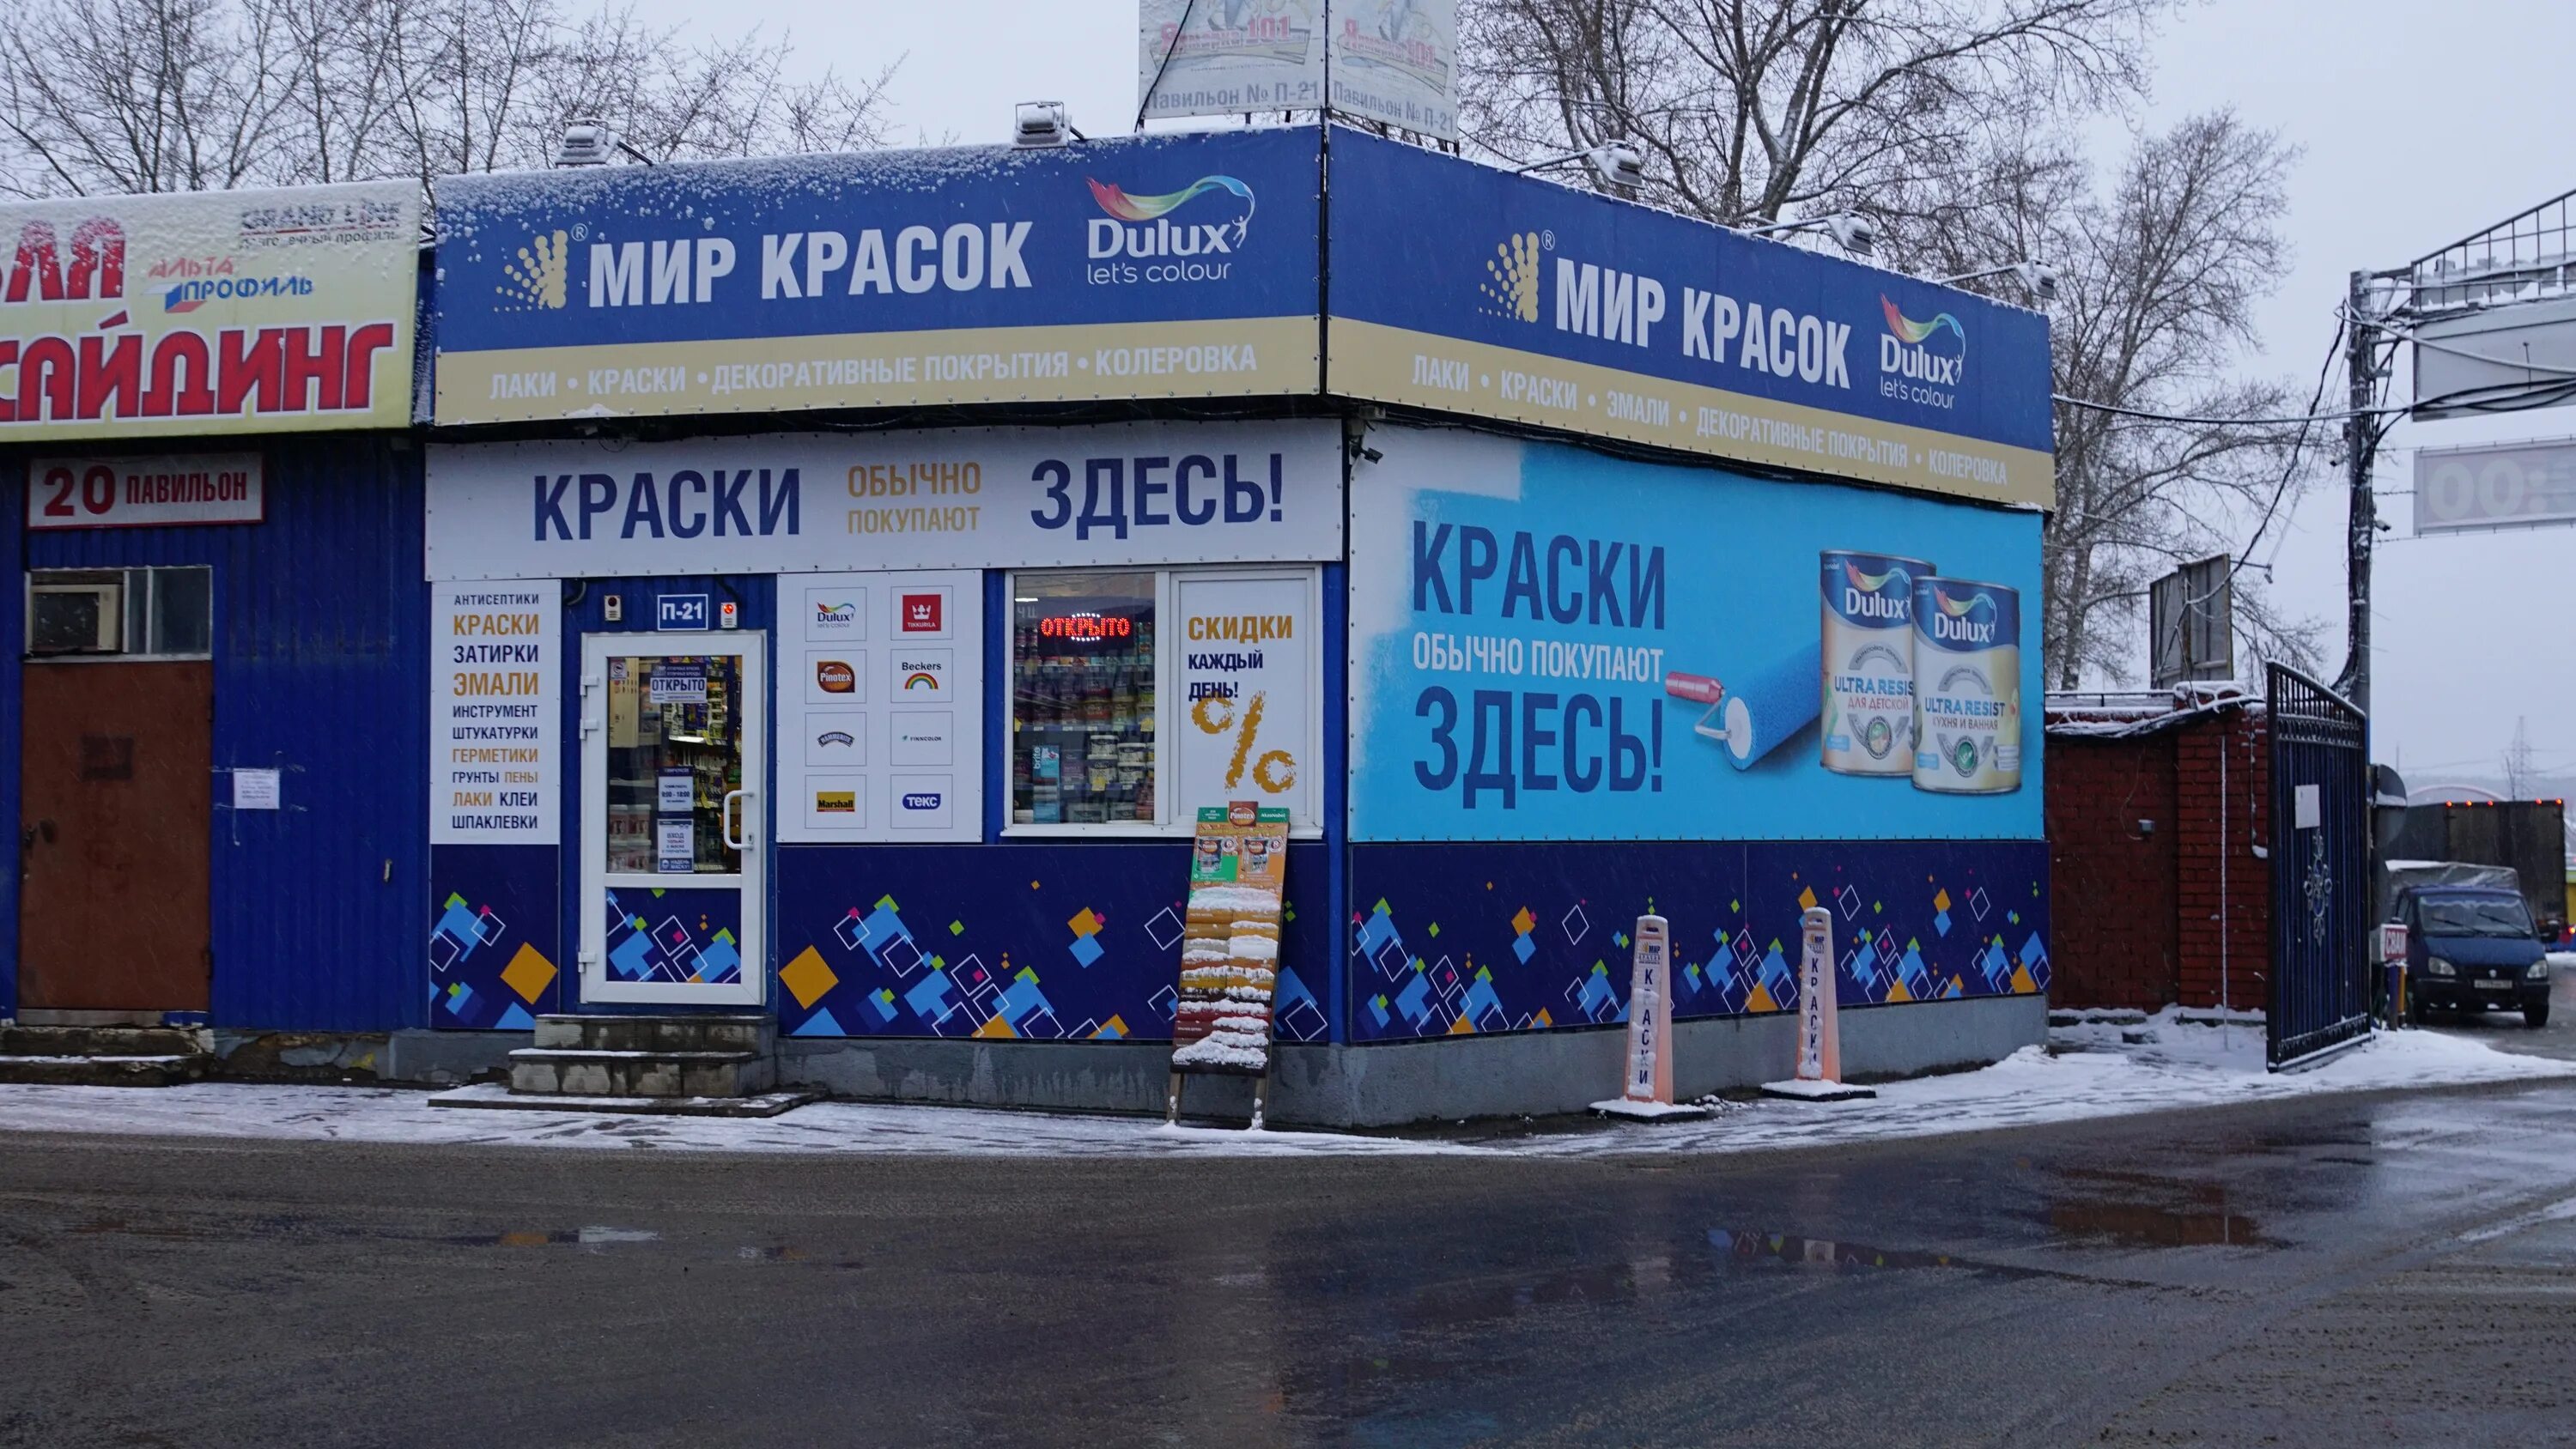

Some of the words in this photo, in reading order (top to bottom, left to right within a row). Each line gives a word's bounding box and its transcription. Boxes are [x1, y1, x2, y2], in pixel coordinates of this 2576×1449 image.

[1145, 88, 1239, 109] Павильон
[1334, 81, 1401, 118] Павильон
[1425, 106, 1453, 133] П-21
[1087, 218, 1232, 258] Dulux
[0, 216, 125, 302] ЛЯ
[589, 238, 736, 307] МИР
[762, 221, 1033, 300] КРАСОК
[1145, 259, 1231, 283] colour
[182, 276, 314, 300] ПРОФИЛЬ
[1556, 257, 1667, 348] МИР
[1683, 287, 1851, 390] КРАСОК
[1880, 333, 1955, 386] Dulux
[489, 372, 556, 400] ЛАКИ
[587, 366, 685, 395] КРАСКИ
[712, 356, 917, 395] ДЕКОРАТИВНЫЕ
[925, 350, 1069, 383] ПОКРЫТИЯ
[1096, 344, 1258, 376] КОЛЕРОВКА
[1911, 385, 1955, 409] colour
[1412, 355, 1470, 392] ЛАКИ
[1500, 370, 1577, 410] КРАСКИ
[1607, 390, 1669, 427] ЭМАЛИ
[1696, 407, 1825, 455] ДЕКОРАТИВНЫЕ
[1828, 430, 1908, 468] ПОКРЫТИЯ
[1929, 448, 2008, 486] КОЛЕРОВКА
[45, 465, 115, 516] 20
[125, 471, 248, 504] ПАВИЛЬОН
[848, 462, 981, 498] ОБЫЧНО
[533, 468, 800, 541] КРАСКИ
[1030, 453, 1284, 541] ЗДЕСЬ!
[848, 506, 981, 535] ПОКУПАЮТ
[1413, 520, 1665, 630] КРАСКИ
[454, 593, 539, 605] АНТИСЕПТИКИ
[1845, 587, 1905, 619] Dulux
[662, 603, 702, 621] П-21
[817, 612, 850, 622] Dulux
[453, 614, 539, 636] КРАСКИ
[1041, 617, 1131, 637] ОТКРЫТО
[1188, 615, 1292, 644] СКИДКИ
[1935, 612, 1990, 643] Dulux
[453, 645, 538, 664] ЗАТИРКИ
[902, 662, 941, 670] Beckers
[1188, 649, 1263, 672] КАЖДЫЙ
[1413, 631, 1524, 676] ОБЫЧНО
[1531, 640, 1664, 683] ПОКУПАЮТ
[453, 672, 539, 696] ЭМАЛИ
[652, 679, 705, 691] ОТКРЫТО
[820, 672, 852, 682] Pinotex
[1834, 676, 1876, 694] ULTRA
[1878, 679, 1914, 696] RESIS
[1188, 682, 1239, 701] ДЕНЬ!
[453, 705, 538, 718] ИНСТРУМЕНТ
[1848, 696, 1867, 709] ДЛЯ
[1868, 697, 1909, 711] ДЕТСКОЙ
[1925, 697, 1963, 715] ULTRA
[1965, 700, 2005, 717] RESIST
[453, 726, 538, 740] ШТУКАТУРКИ
[1932, 717, 1958, 729] КУХНЯ
[1959, 719, 1966, 729] И
[1968, 719, 1998, 731] ВАННАЯ
[453, 749, 538, 763] ГЕРМЕТИКИ
[1413, 685, 1663, 809] ЗДЕСЬ!
[452, 771, 500, 783] ГРУНТЫ
[504, 771, 538, 783] ПЕНЫ
[453, 791, 492, 807] ЛАКИ
[500, 791, 538, 807] КЛЕИ
[817, 800, 854, 809] Marshall
[452, 815, 538, 829] ШПАКЛЕВКИ
[1230, 811, 1255, 820] Pinotex
